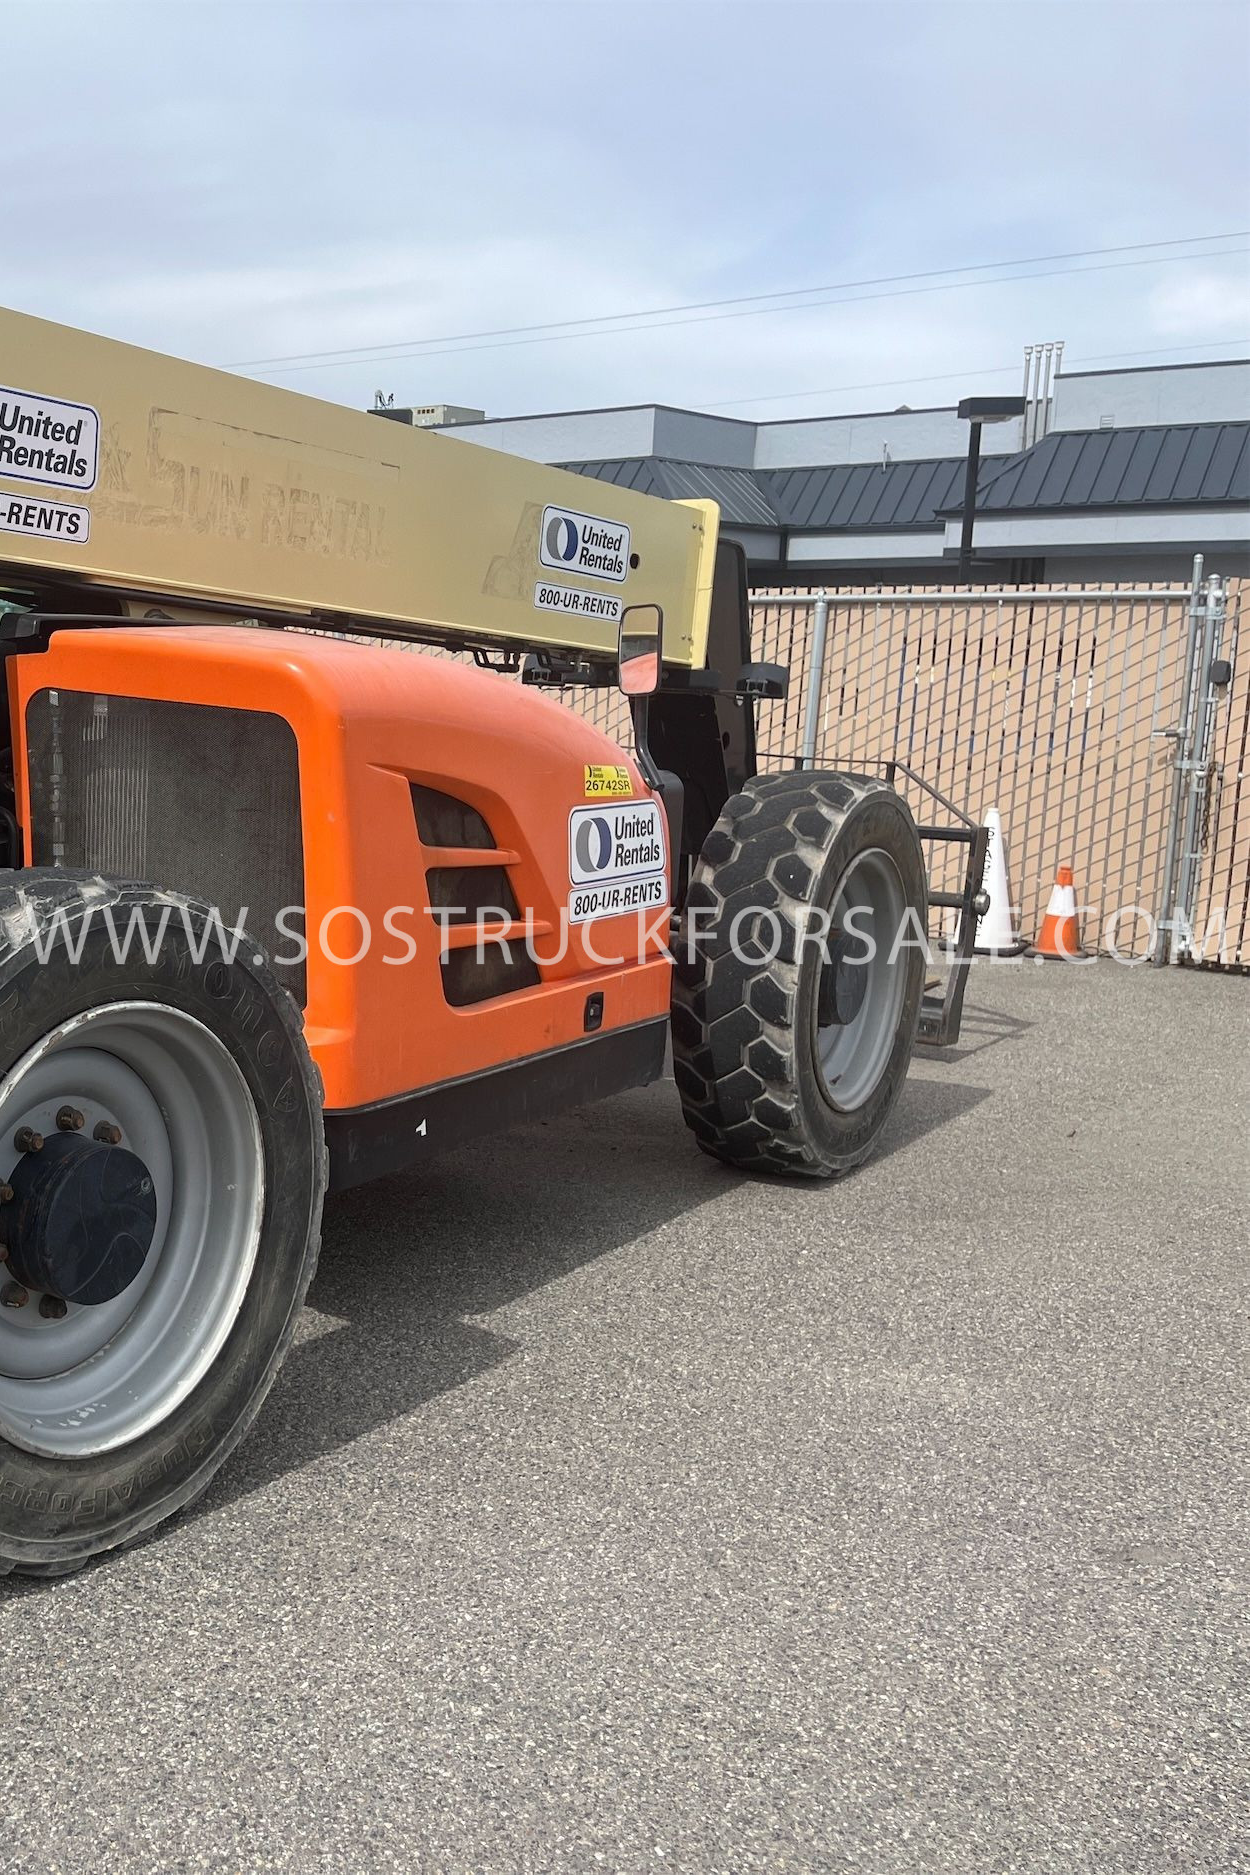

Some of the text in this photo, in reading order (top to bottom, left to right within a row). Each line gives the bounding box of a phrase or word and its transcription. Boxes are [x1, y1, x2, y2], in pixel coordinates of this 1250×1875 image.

[581, 524, 623, 552] United
[578, 546, 624, 574] Rentals
[539, 588, 619, 617] 800-UR-RENTS
[585, 780, 631, 791] 26742SR
[615, 812, 654, 840] United
[615, 839, 660, 867] Rentals
[574, 881, 662, 916] 800-UR-RENTS
